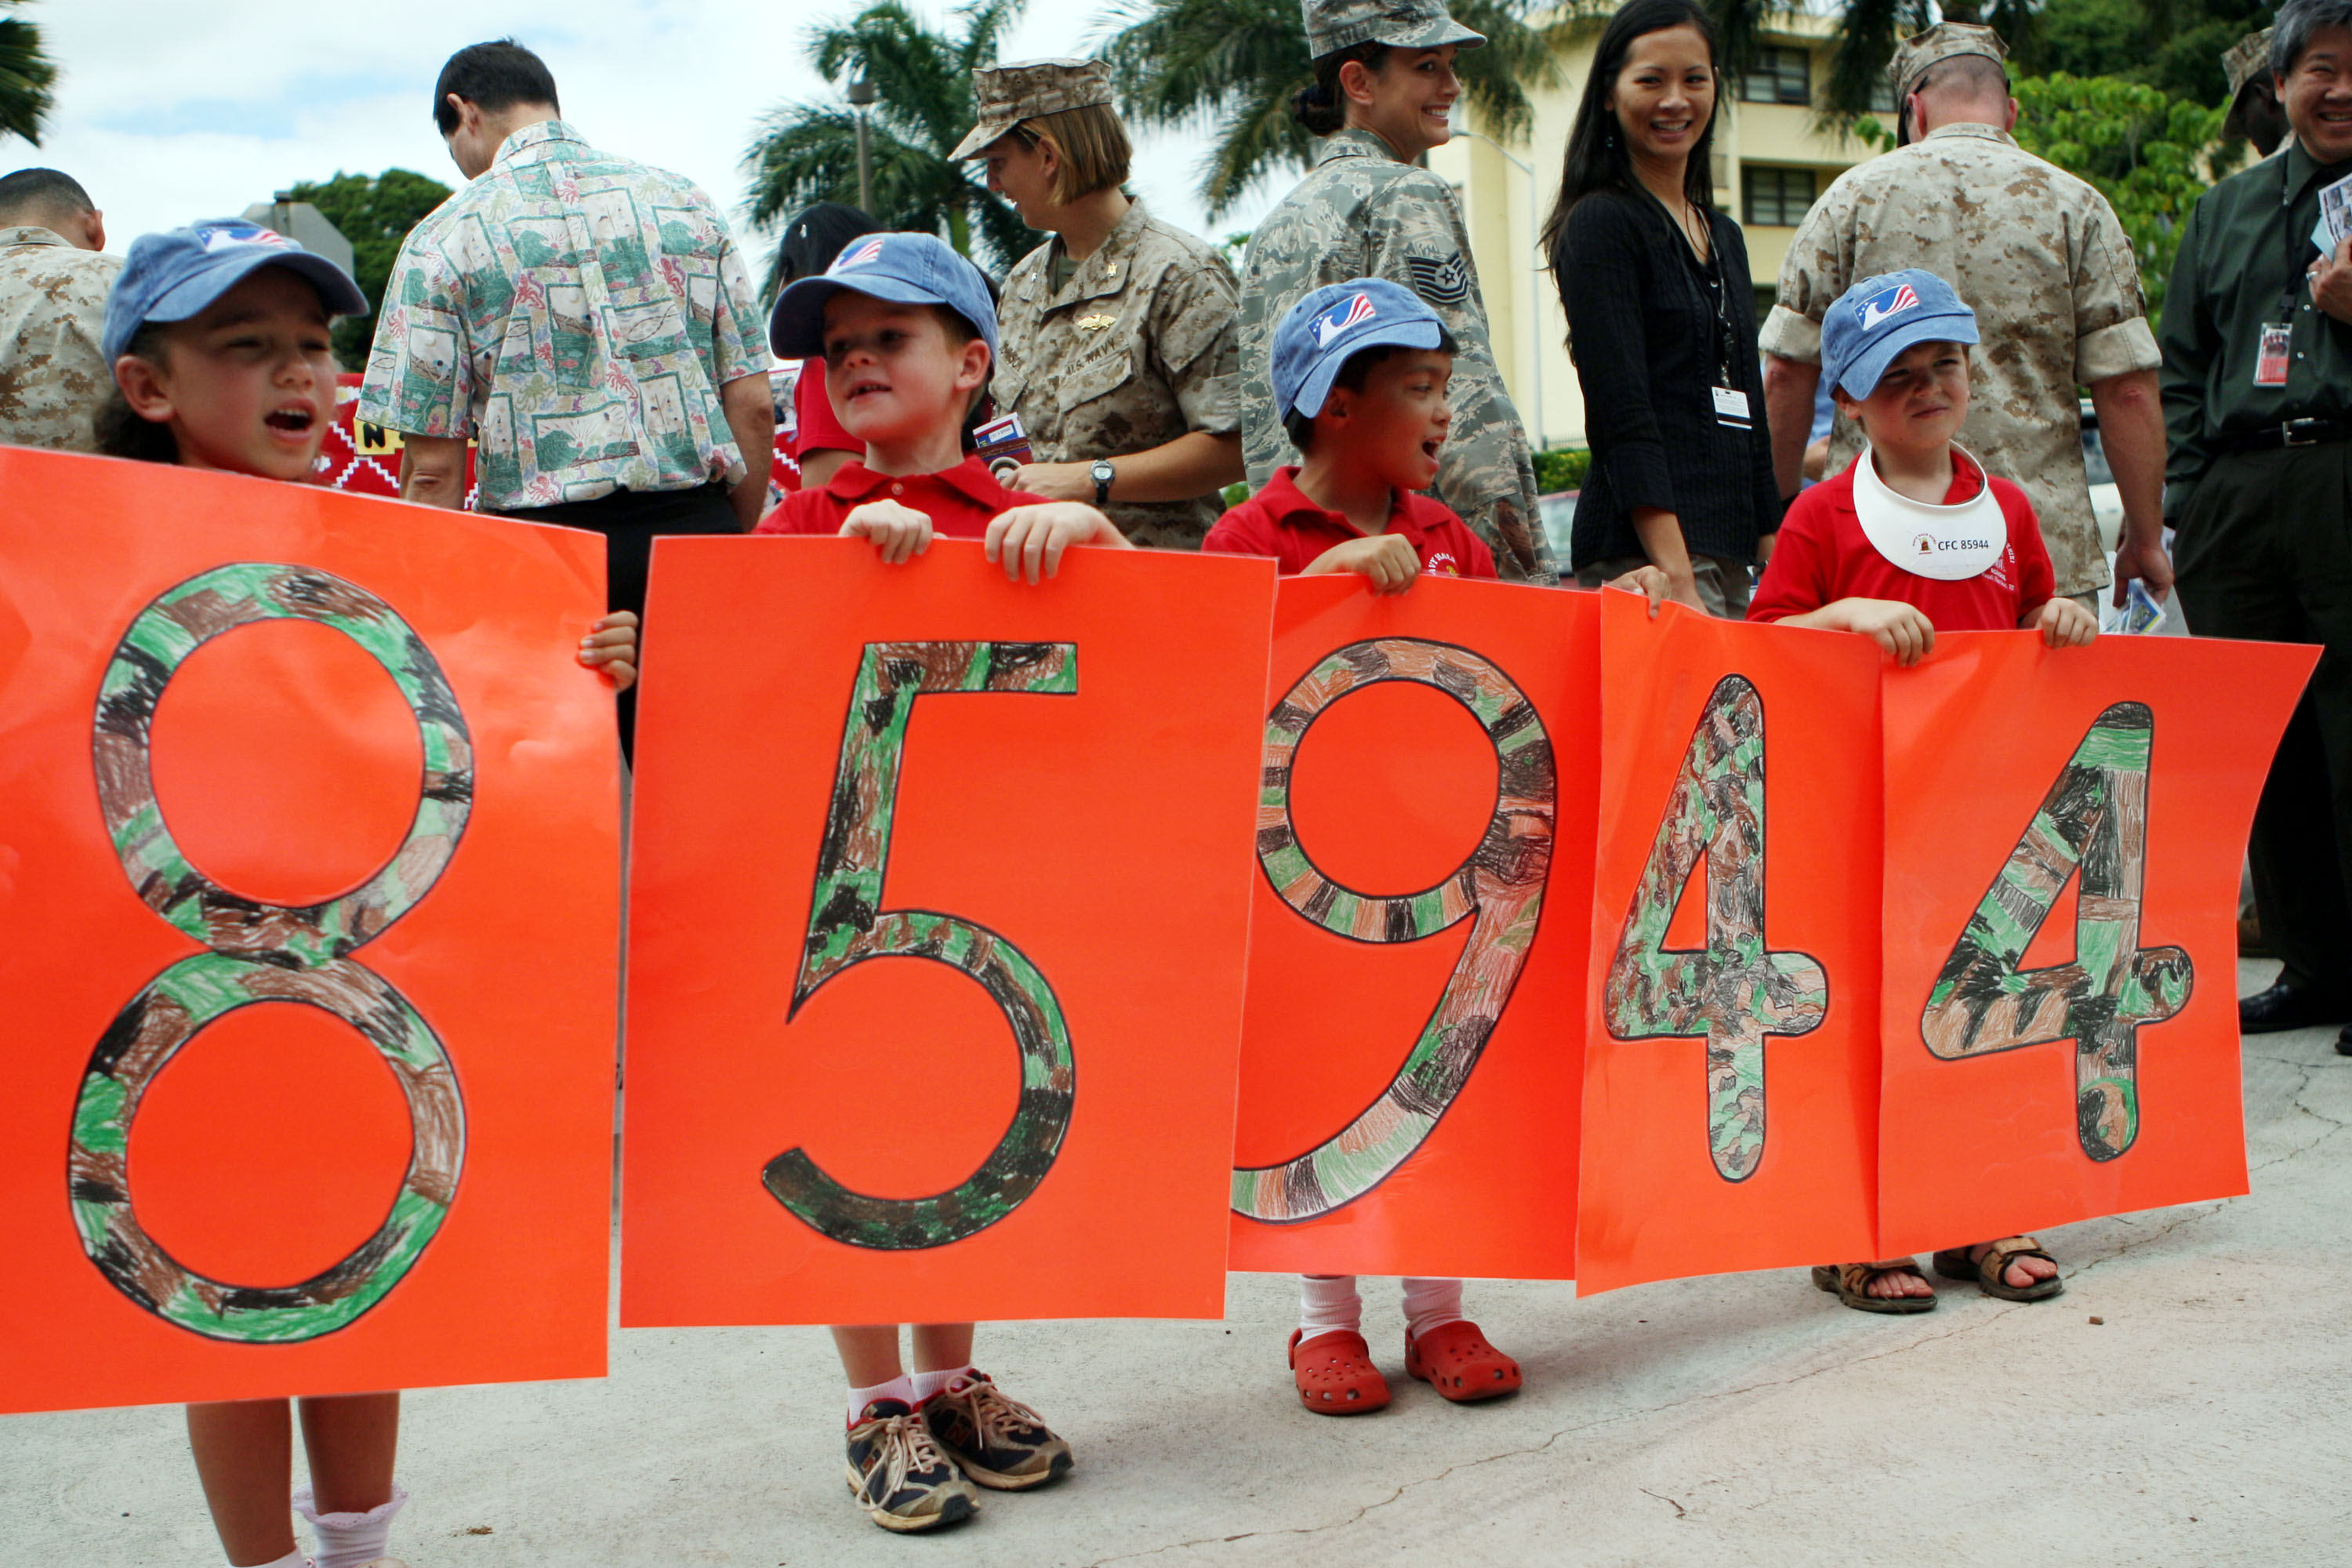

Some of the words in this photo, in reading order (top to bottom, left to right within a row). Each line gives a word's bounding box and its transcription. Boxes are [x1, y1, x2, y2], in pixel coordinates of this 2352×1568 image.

[1084, 337, 1116, 364] NAVY
[1938, 540, 1958, 551] CFC
[1960, 539, 1989, 550] 85944
[67, 561, 475, 1345] 8
[761, 641, 1078, 1250] 5
[1231, 637, 1557, 1225] 9
[1603, 673, 1828, 1182] 4
[1921, 700, 2194, 1162] 4
